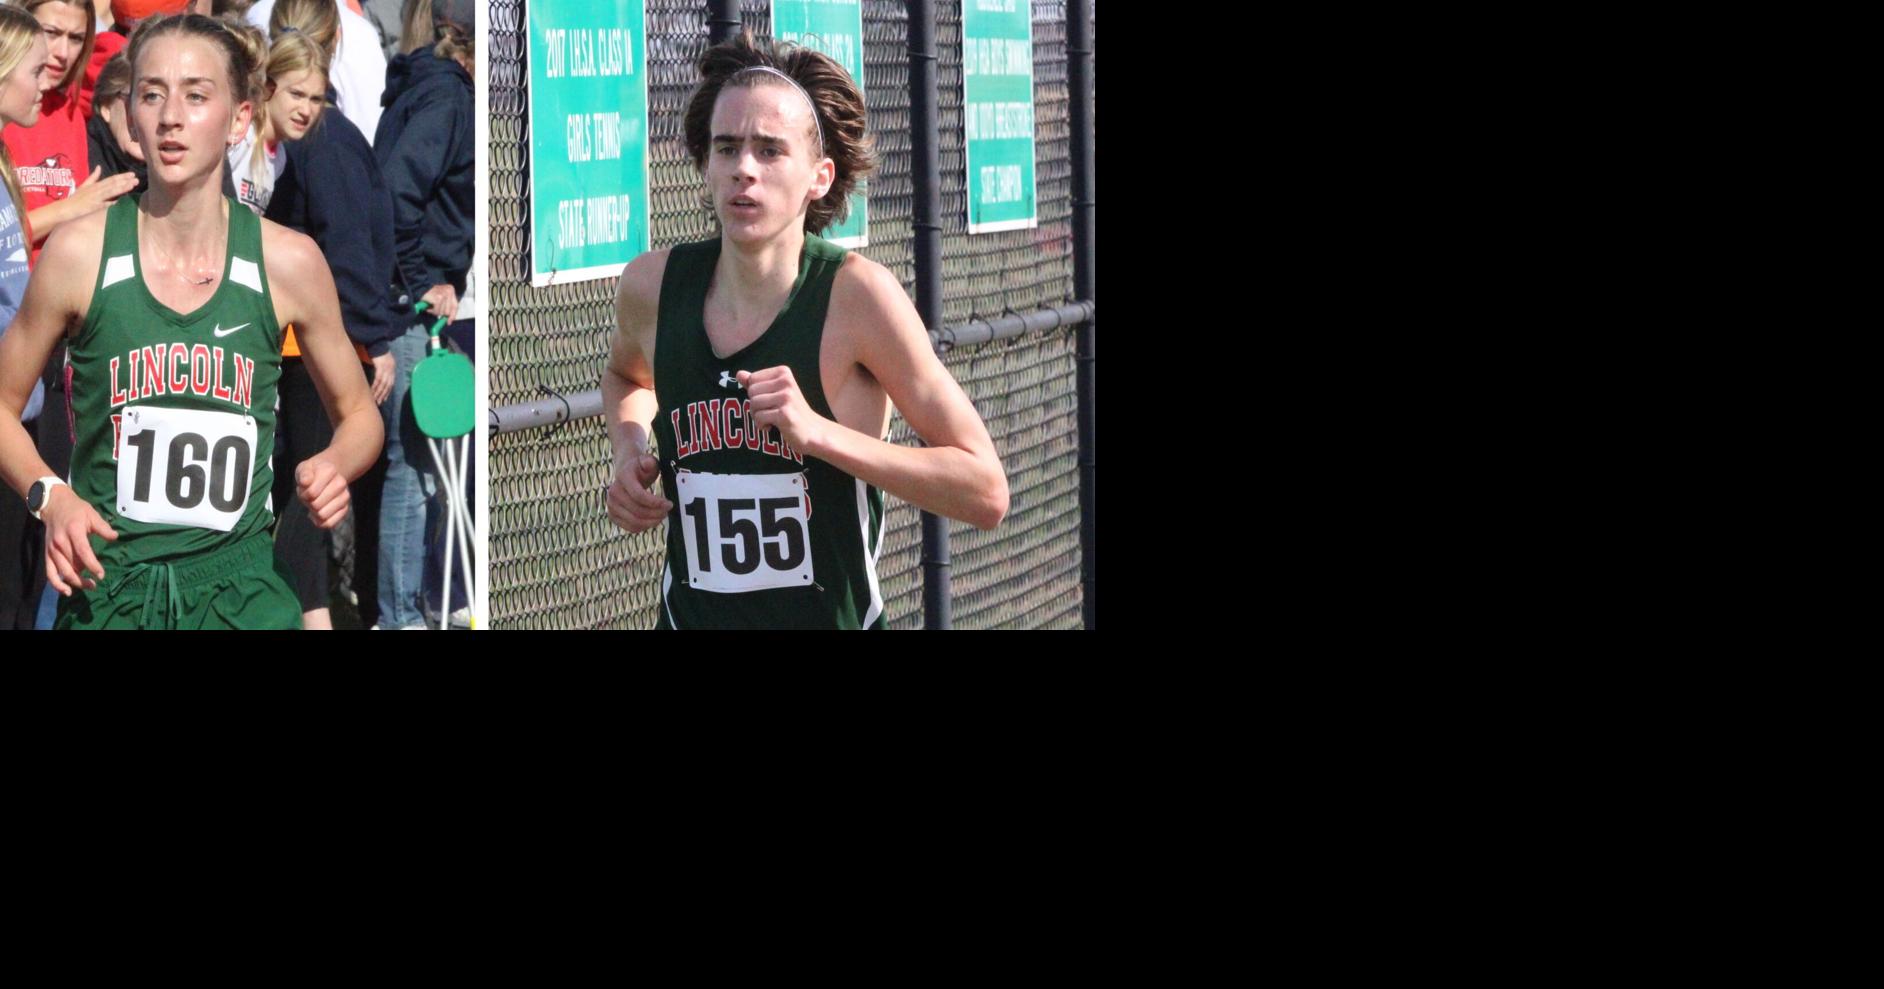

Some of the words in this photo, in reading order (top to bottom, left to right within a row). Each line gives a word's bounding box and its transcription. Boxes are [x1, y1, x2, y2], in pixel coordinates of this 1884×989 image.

[545, 28, 566, 78] 2017
[598, 28, 623, 76] CLASS
[567, 113, 591, 163] GIRLS
[593, 111, 620, 160] TENNIS
[15, 166, 73, 187] REDATORS
[558, 198, 584, 250] STATE
[587, 194, 629, 246] RUNNER-UP
[110, 342, 254, 408] LINCOLN
[127, 428, 251, 513] 160
[685, 496, 805, 575] 155
